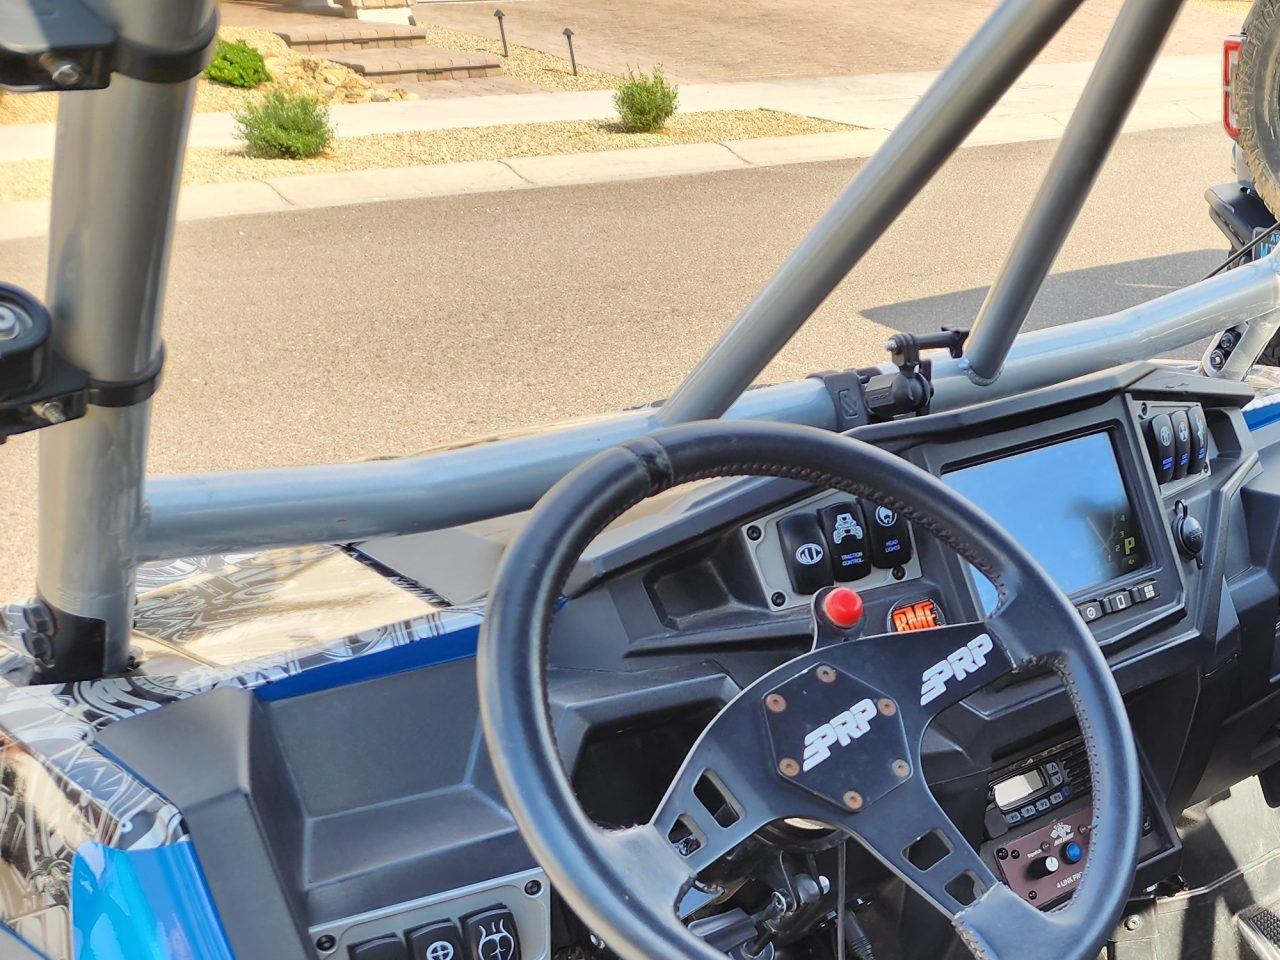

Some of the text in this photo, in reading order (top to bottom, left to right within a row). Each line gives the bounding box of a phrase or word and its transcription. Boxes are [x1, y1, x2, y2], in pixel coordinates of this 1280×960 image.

[1124, 536, 1136, 555] P
[841, 552, 863, 561] TRACTION
[841, 558, 864, 566] CONTROL
[1061, 876, 1074, 888] LINK
